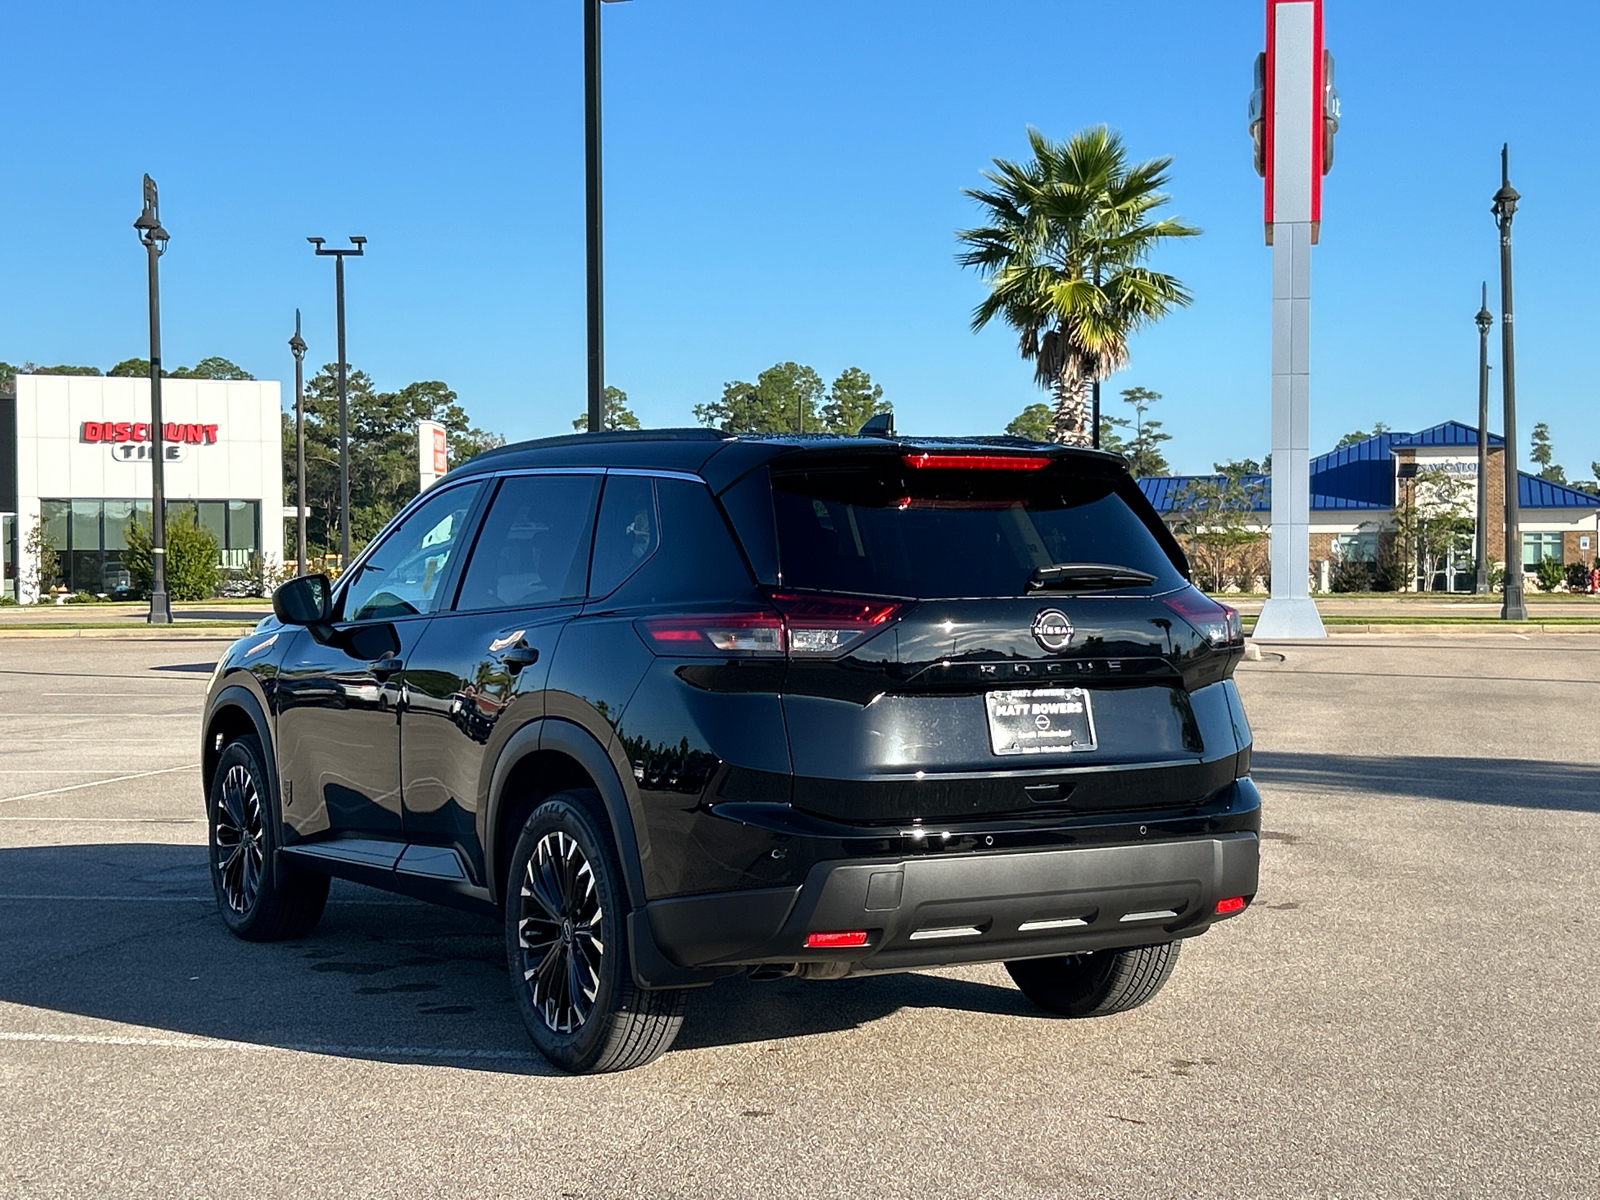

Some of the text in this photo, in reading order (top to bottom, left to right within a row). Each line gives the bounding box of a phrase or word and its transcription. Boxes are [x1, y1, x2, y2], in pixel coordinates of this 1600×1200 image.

[1034, 625, 1075, 635] NISSAN
[980, 661, 1122, 675] ROGUE
[996, 702, 1083, 716] MATT BOWERS
